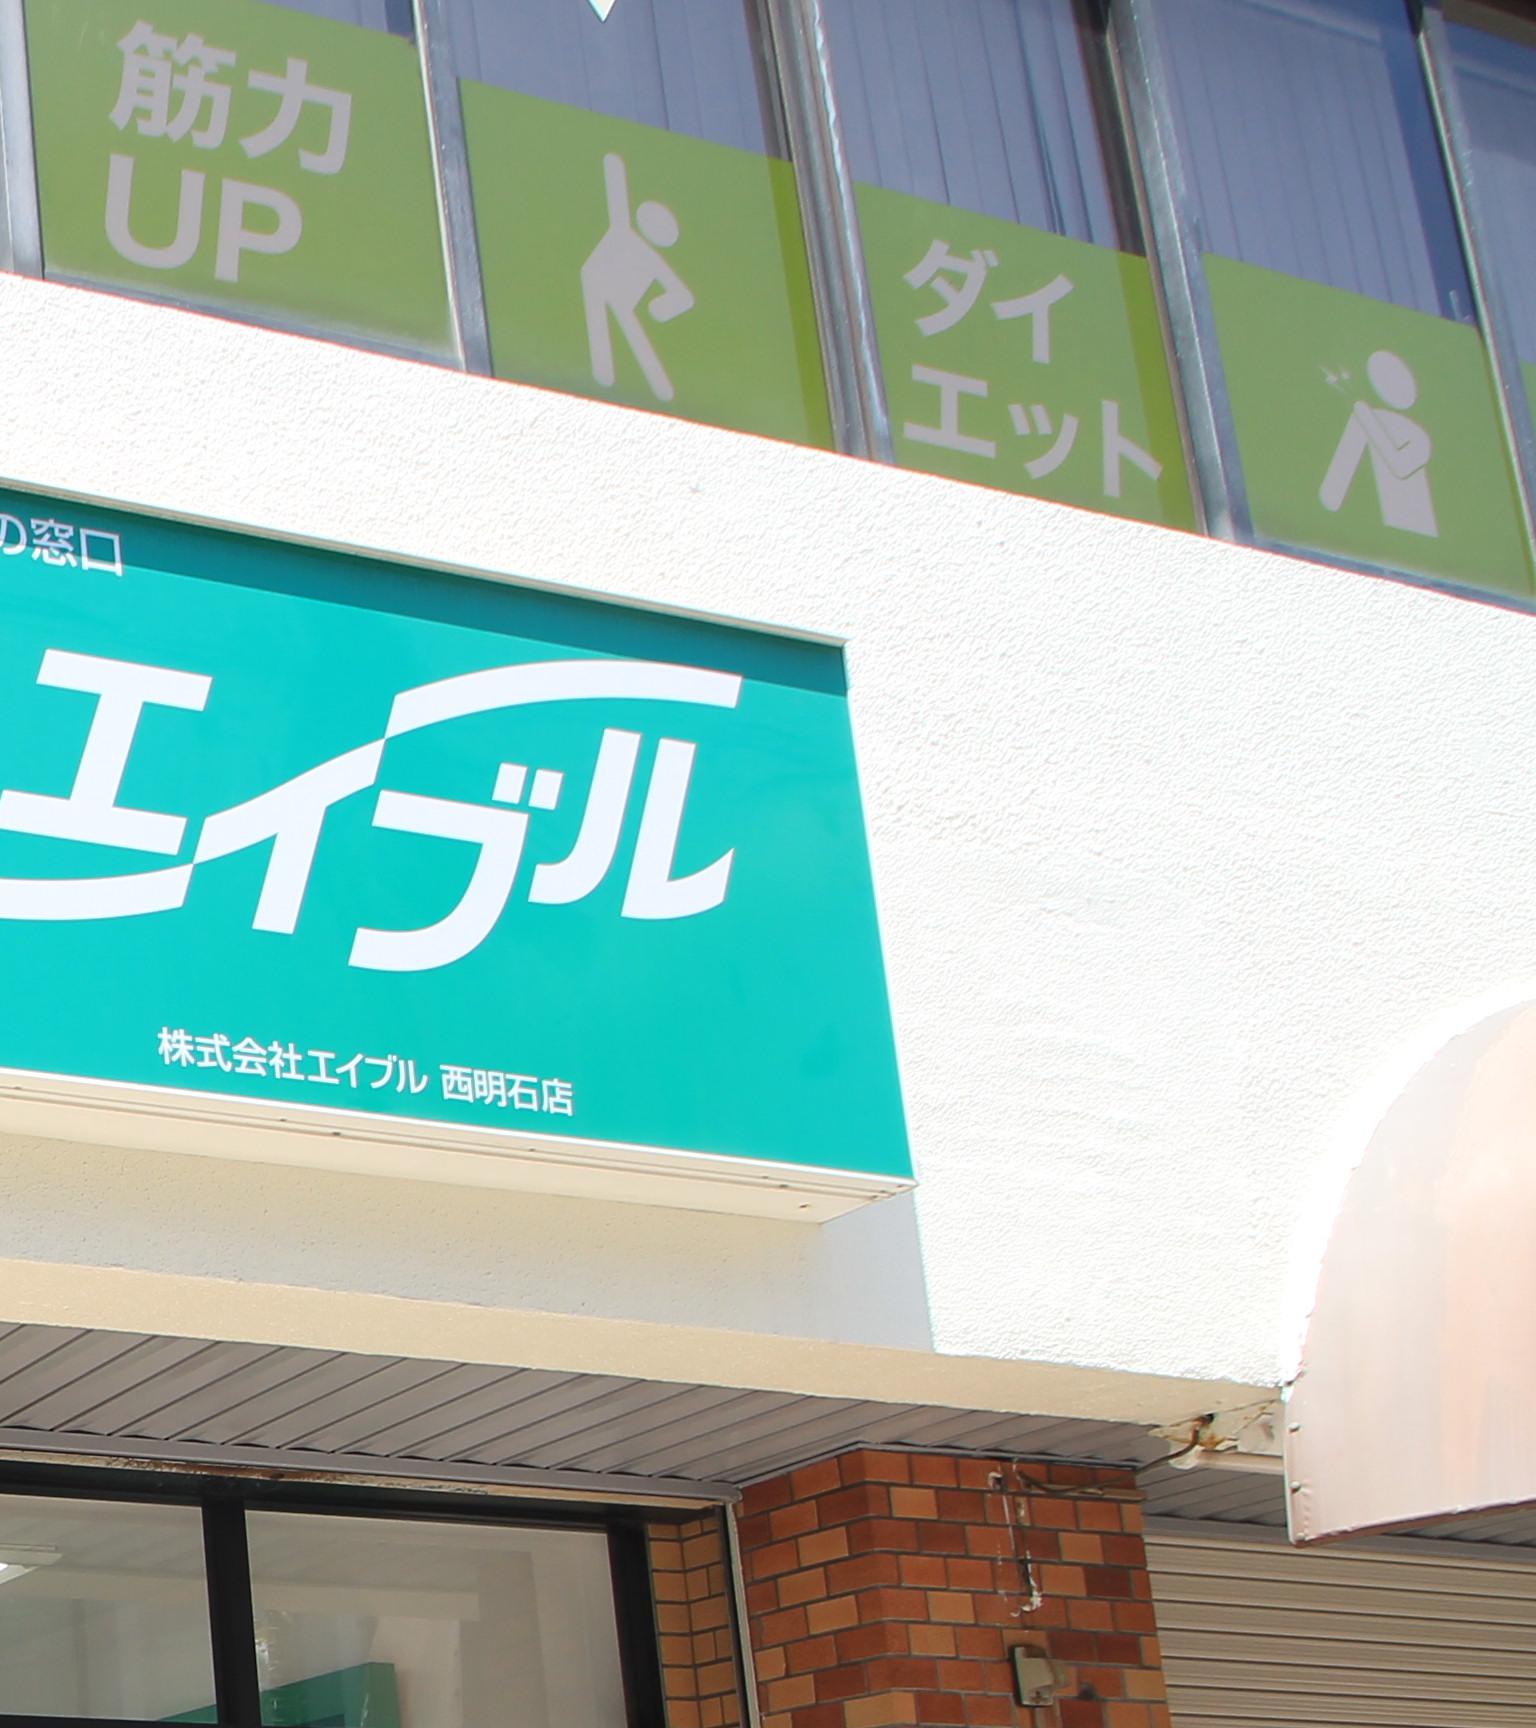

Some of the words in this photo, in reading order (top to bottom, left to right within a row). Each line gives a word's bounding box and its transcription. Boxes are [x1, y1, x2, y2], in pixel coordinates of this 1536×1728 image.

[108, 22, 355, 175] 筋力
[103, 152, 305, 283] UP
[903, 237, 1074, 364] ダイ
[901, 364, 1164, 500] エット
[156, 1026, 429, 1098] 株式会社エイブル
[439, 1061, 575, 1119] 西明石店
